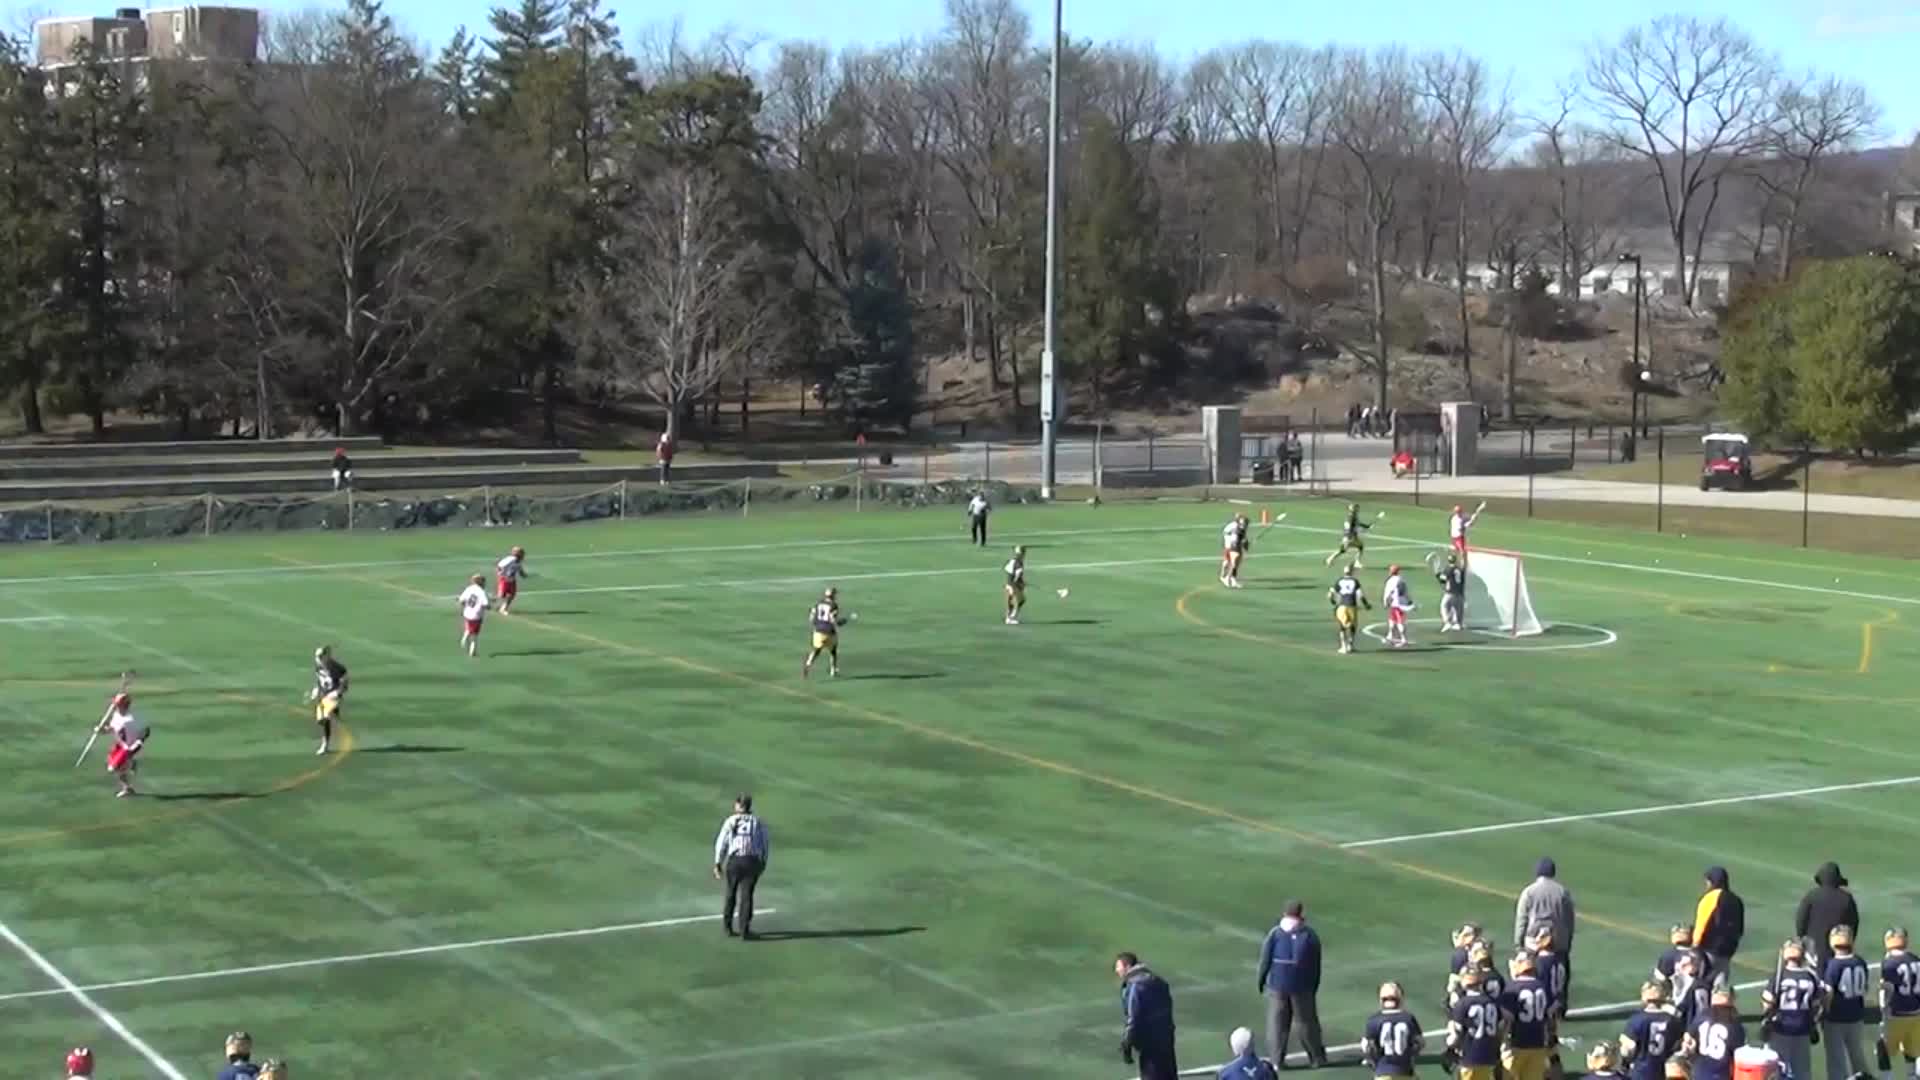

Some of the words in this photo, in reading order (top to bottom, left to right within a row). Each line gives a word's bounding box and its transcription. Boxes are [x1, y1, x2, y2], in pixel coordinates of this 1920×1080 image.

[1779, 979, 1815, 1010] 27
[1839, 967, 1865, 998] 40
[1468, 1004, 1498, 1038] 39
[1518, 988, 1546, 1022] 30
[1380, 1022, 1409, 1056] 40
[1648, 1021, 1668, 1056] 5
[1698, 1021, 1728, 1060] 16
